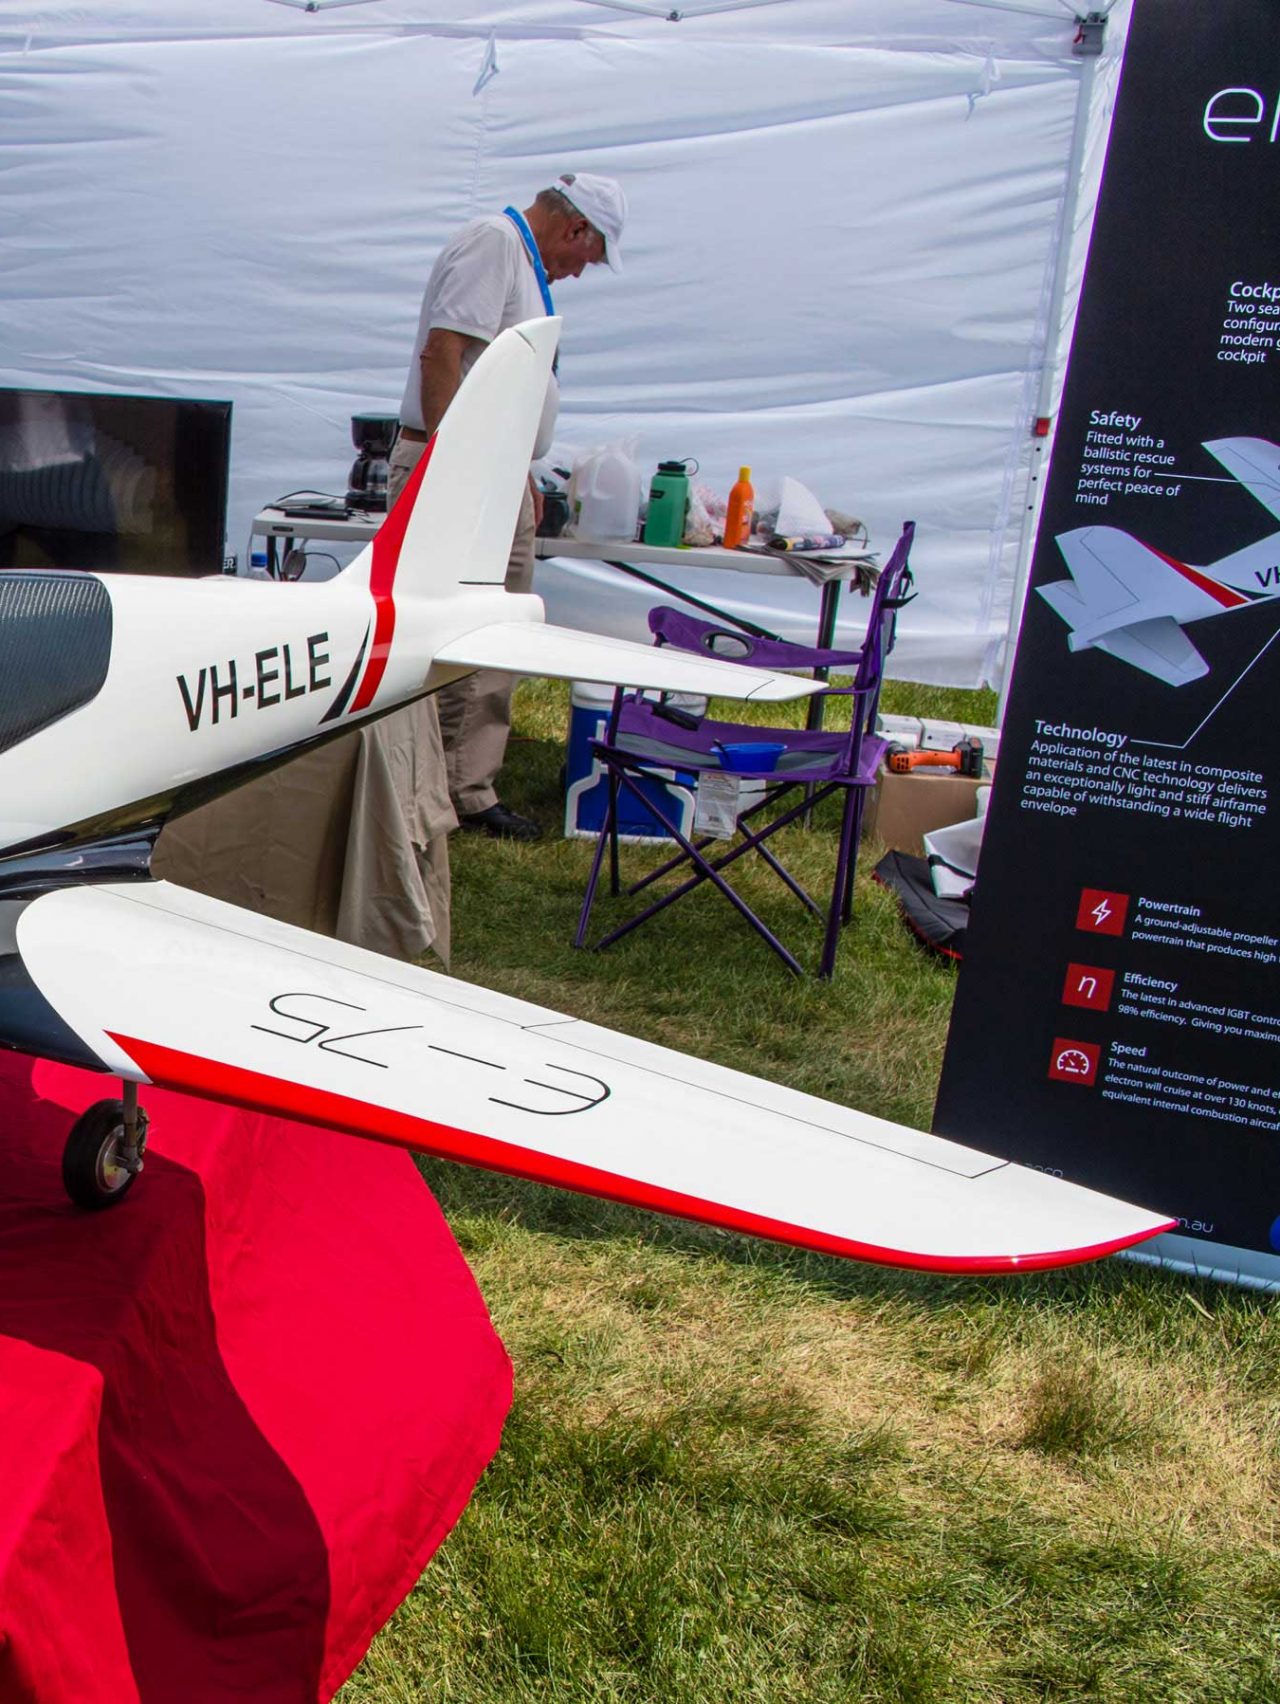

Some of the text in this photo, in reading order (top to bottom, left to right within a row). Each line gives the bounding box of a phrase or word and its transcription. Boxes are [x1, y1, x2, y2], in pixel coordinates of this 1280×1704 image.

[1227, 300, 1255, 314] Two
[1220, 333, 1273, 347] modern
[1217, 348, 1267, 365] cockpit
[1089, 409, 1142, 431] Safety
[1086, 430, 1165, 449] Fitted with a
[1083, 445, 1176, 465] ballistic rescue
[1080, 463, 1152, 478] systems for
[1075, 492, 1109, 505] mind
[1077, 477, 1181, 497] perfect peace of
[176, 631, 332, 732] VH-ELE
[1034, 719, 1128, 748] Technology
[1030, 740, 1264, 783] Application of the latest in composite
[1028, 756, 1268, 800] materials and CNC technology delivers
[1022, 784, 1253, 829] capable of withstanding a wide flight
[1025, 771, 1267, 815] an exceptionally light and stiff airframe
[1020, 799, 1078, 817] envelope
[1138, 897, 1201, 917] Powertrain
[1134, 914, 1278, 947] A ground-adjustable propeller
[1131, 930, 1277, 964] powertrain that produces high
[1123, 972, 1179, 993] Efficiency
[1120, 988, 1139, 1000] The
[1140, 992, 1166, 1005] latest
[1167, 996, 1177, 1007] in
[1178, 1000, 1226, 1016] advanced
[1227, 1008, 1251, 1020] IGBT
[1118, 1004, 1139, 1016] 98%
[1140, 1009, 1187, 1027] efficiency.
[1191, 1017, 1222, 1033] Giving
[1223, 1023, 1243, 1035] you
[250, 992, 612, 1116] E-75
[1110, 1041, 1147, 1059] Speed
[1107, 1057, 1126, 1070] The
[1126, 1063, 1161, 1076] natural
[1161, 1070, 1205, 1084] outcome
[1206, 1075, 1219, 1085] of
[1218, 1080, 1250, 1093] power
[1250, 1085, 1271, 1098] and
[1102, 1088, 1152, 1106] equivalent
[1152, 1097, 1190, 1113] internal
[1190, 1106, 1248, 1125] combustion
[1104, 1074, 1277, 1116] electron will cruise at over 130 knots,
